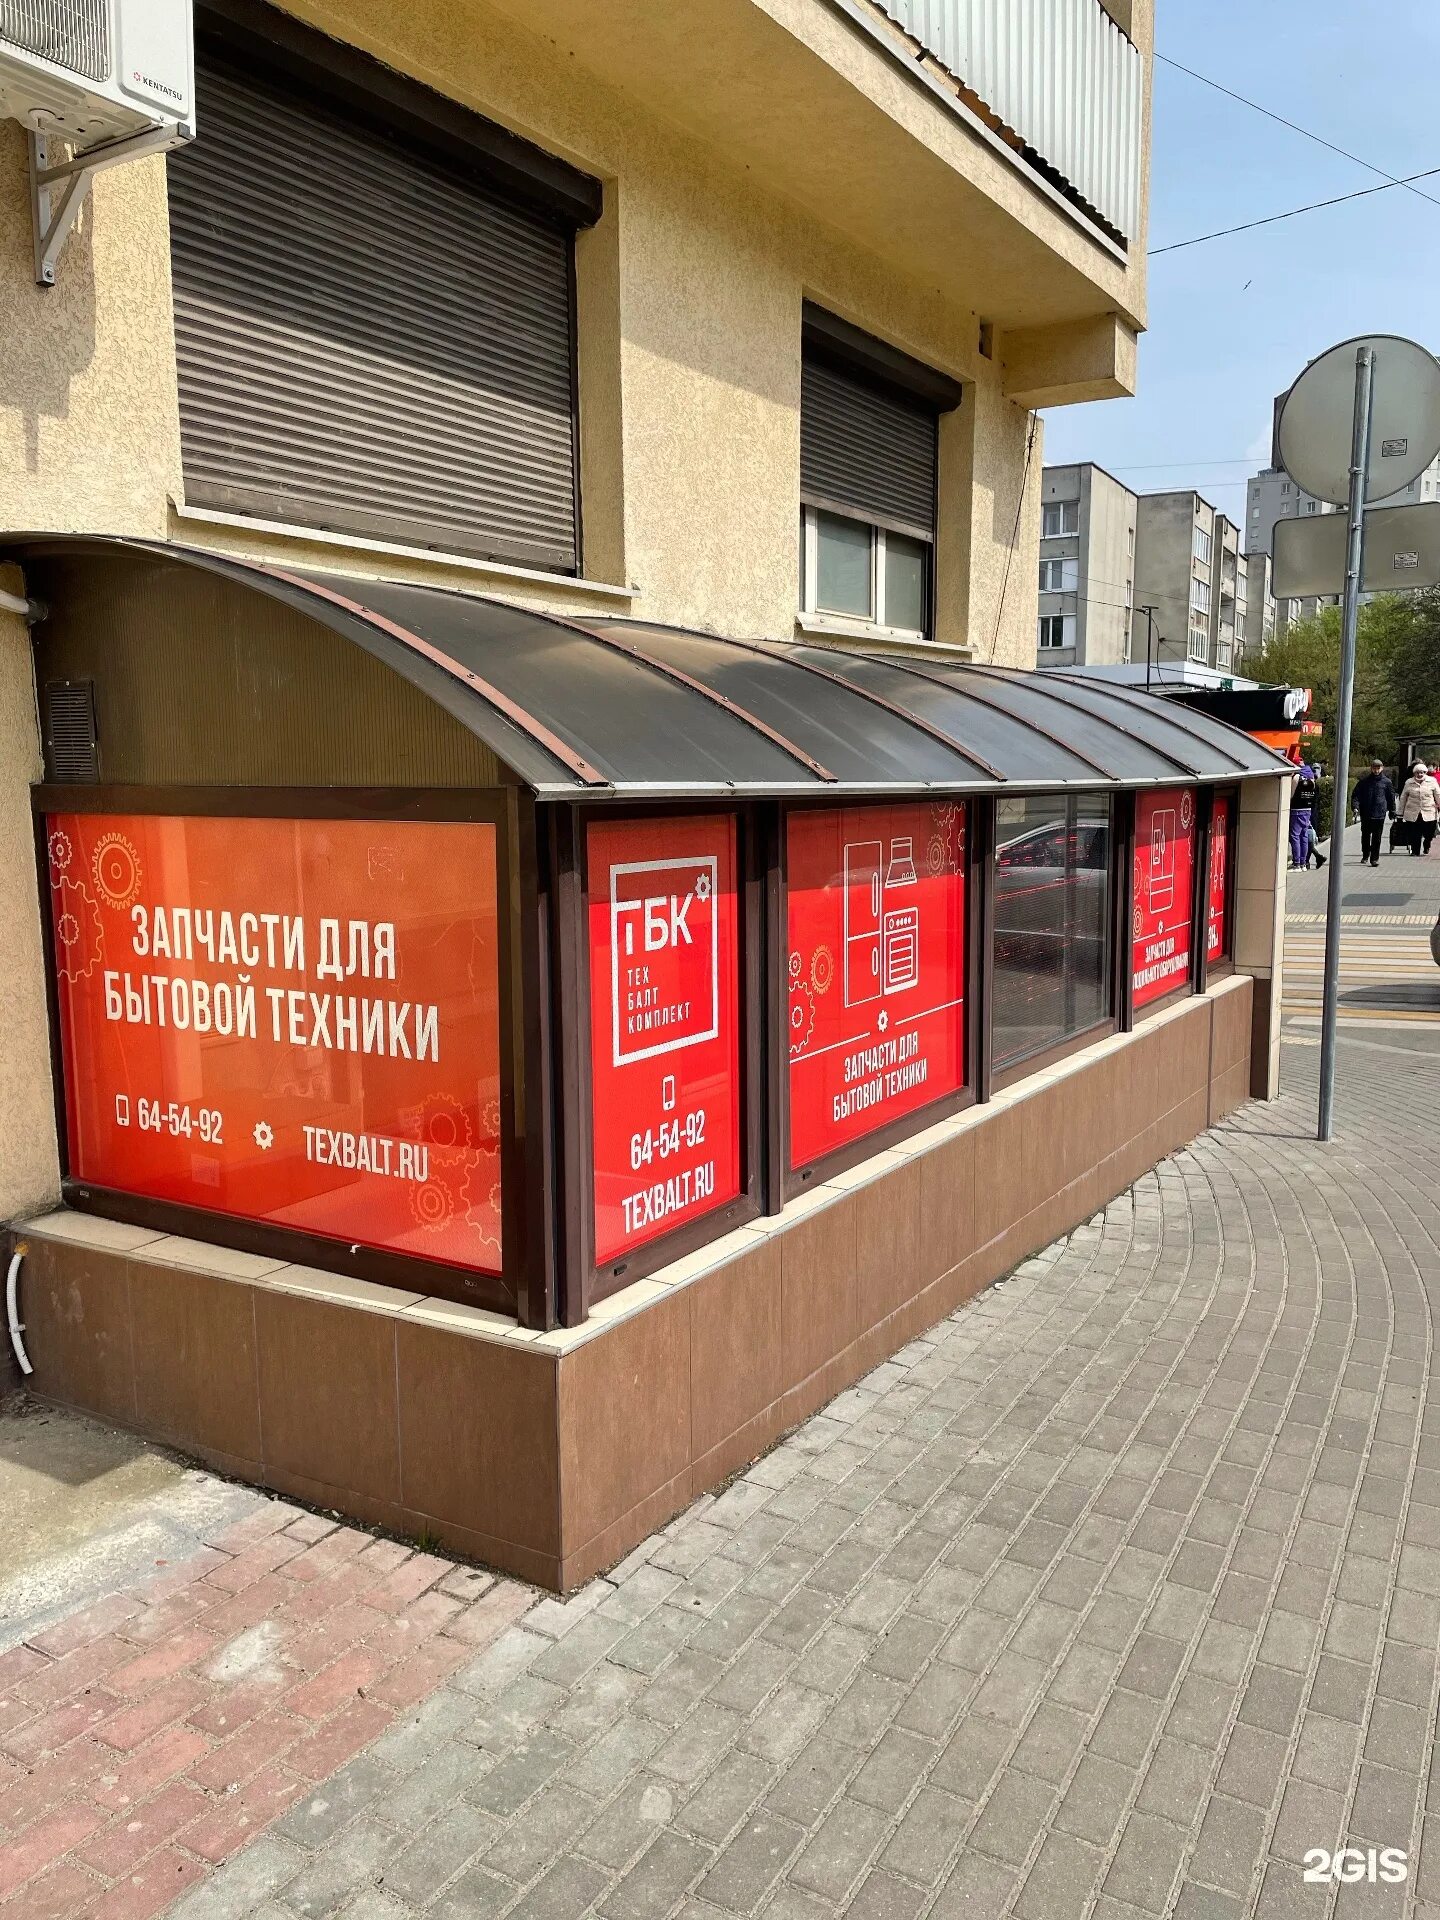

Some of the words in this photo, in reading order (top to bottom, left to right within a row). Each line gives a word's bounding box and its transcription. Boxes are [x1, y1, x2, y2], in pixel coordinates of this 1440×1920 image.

[143, 77, 183, 101] KENTATSU
[131, 904, 305, 971] ЗАПЧАСТИ
[317, 918, 396, 982] ДЛЯ
[628, 966, 650, 986] ТЕХ
[628, 987, 659, 1011] БАЛТ
[104, 971, 257, 1039] БЫТОВОЙ
[266, 988, 440, 1063] ТЕХНИКИ
[628, 1001, 691, 1034] КОМПЛЕКТ
[844, 1039, 897, 1083] ЗАПЧАСТИ
[898, 1030, 918, 1064] ДЛЯ
[833, 1071, 883, 1122] БЫТОВОЙ
[884, 1057, 927, 1098] ТЕХНИКИ
[138, 1098, 223, 1145] 64-54-92
[630, 1109, 706, 1171] 64-54-92
[303, 1126, 429, 1182] TEXBALT.RU
[621, 1160, 715, 1234] TEXBALT.RU
